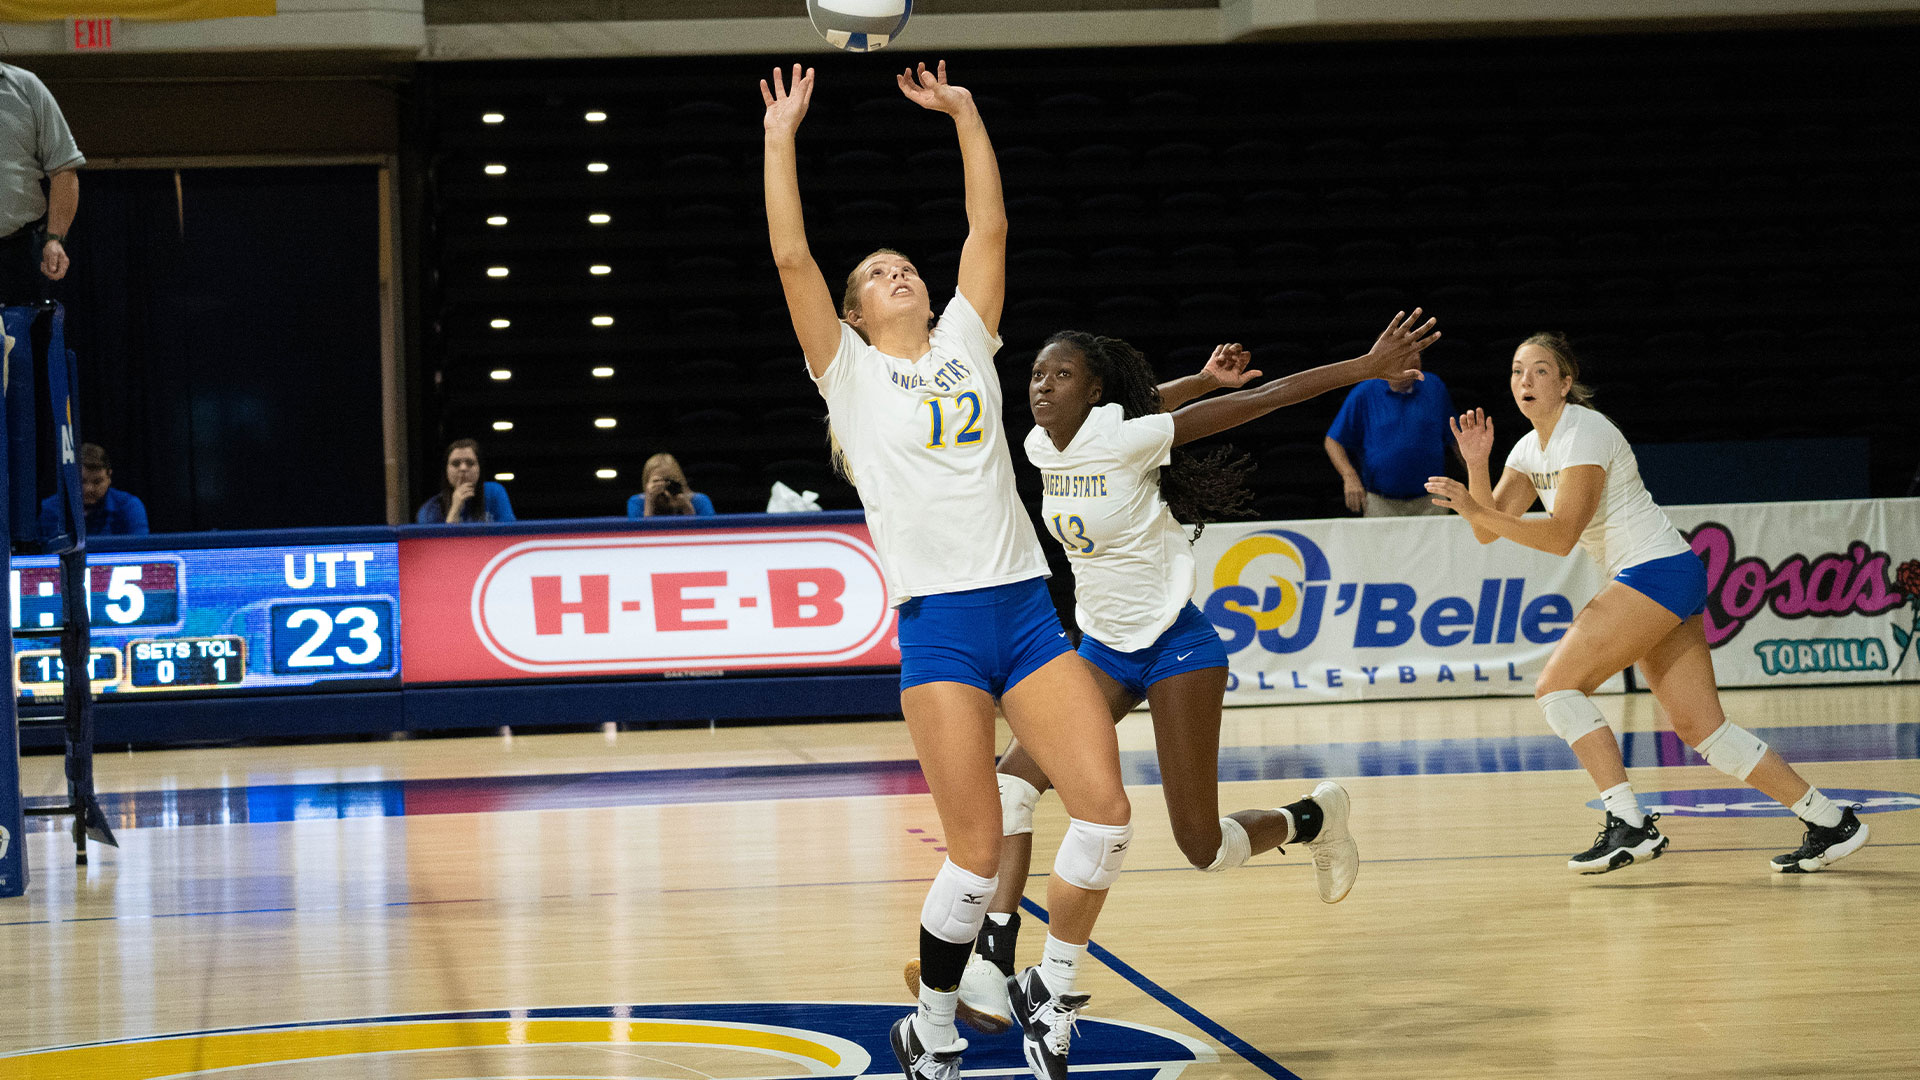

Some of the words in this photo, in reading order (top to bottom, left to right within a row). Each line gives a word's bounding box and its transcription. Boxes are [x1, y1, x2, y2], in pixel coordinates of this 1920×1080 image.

[74, 19, 112, 49] EXIT
[924, 390, 983, 449] 12
[1042, 473, 1070, 497] NGELO
[1073, 473, 1107, 498] STATE
[1052, 513, 1095, 555] 13
[284, 551, 374, 589] UTT
[530, 567, 847, 636] H-E-B
[136, 642, 191, 660] SETS
[196, 640, 237, 658] TOL
[286, 607, 383, 669] 23
[157, 660, 175, 683] 0
[213, 658, 227, 681] 1
[1757, 640, 1884, 671] TORTILLA
[1226, 662, 1523, 692] OLLEYBALL
